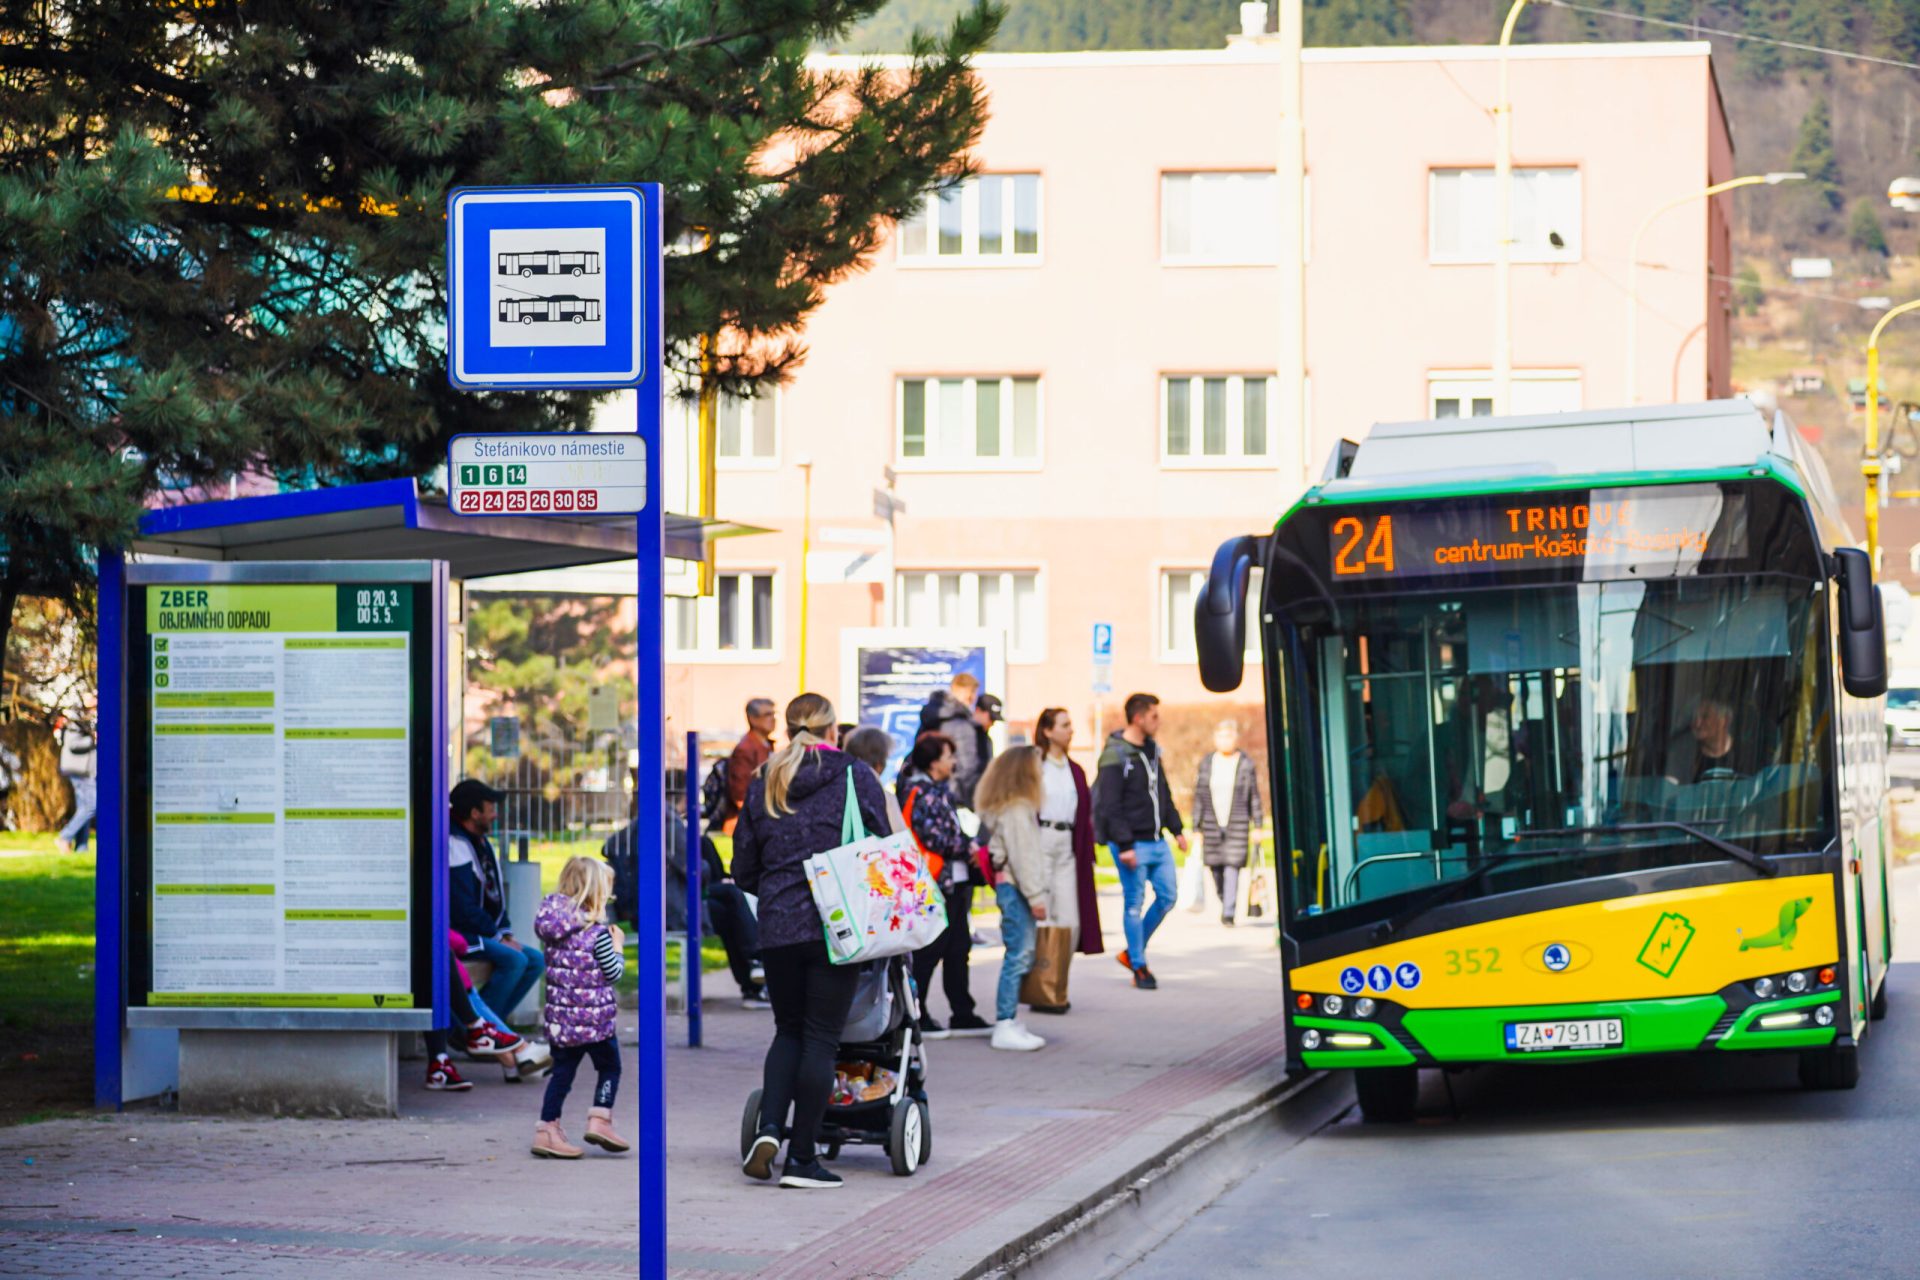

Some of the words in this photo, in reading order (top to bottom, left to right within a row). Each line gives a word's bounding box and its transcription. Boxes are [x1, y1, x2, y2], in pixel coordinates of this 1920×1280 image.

[475, 437, 556, 457] Štefánikovo
[561, 440, 625, 456] námestie
[466, 468, 474, 483] 1
[488, 468, 498, 483] 6
[508, 468, 525, 482] 14
[462, 495, 479, 509] 22
[485, 495, 502, 509] 24
[508, 495, 525, 508] 25
[532, 494, 549, 508] 26
[555, 494, 572, 507] 30
[578, 493, 596, 507] 35
[1333, 514, 1394, 575] 24
[160, 590, 208, 608] ZBER
[357, 589, 371, 607] OD
[159, 607, 224, 630] OBJEMNÉHO
[227, 610, 271, 629] ODPADU
[357, 606, 371, 624] DO
[1444, 947, 1503, 976] 352
[1519, 1025, 1544, 1045] ZA
